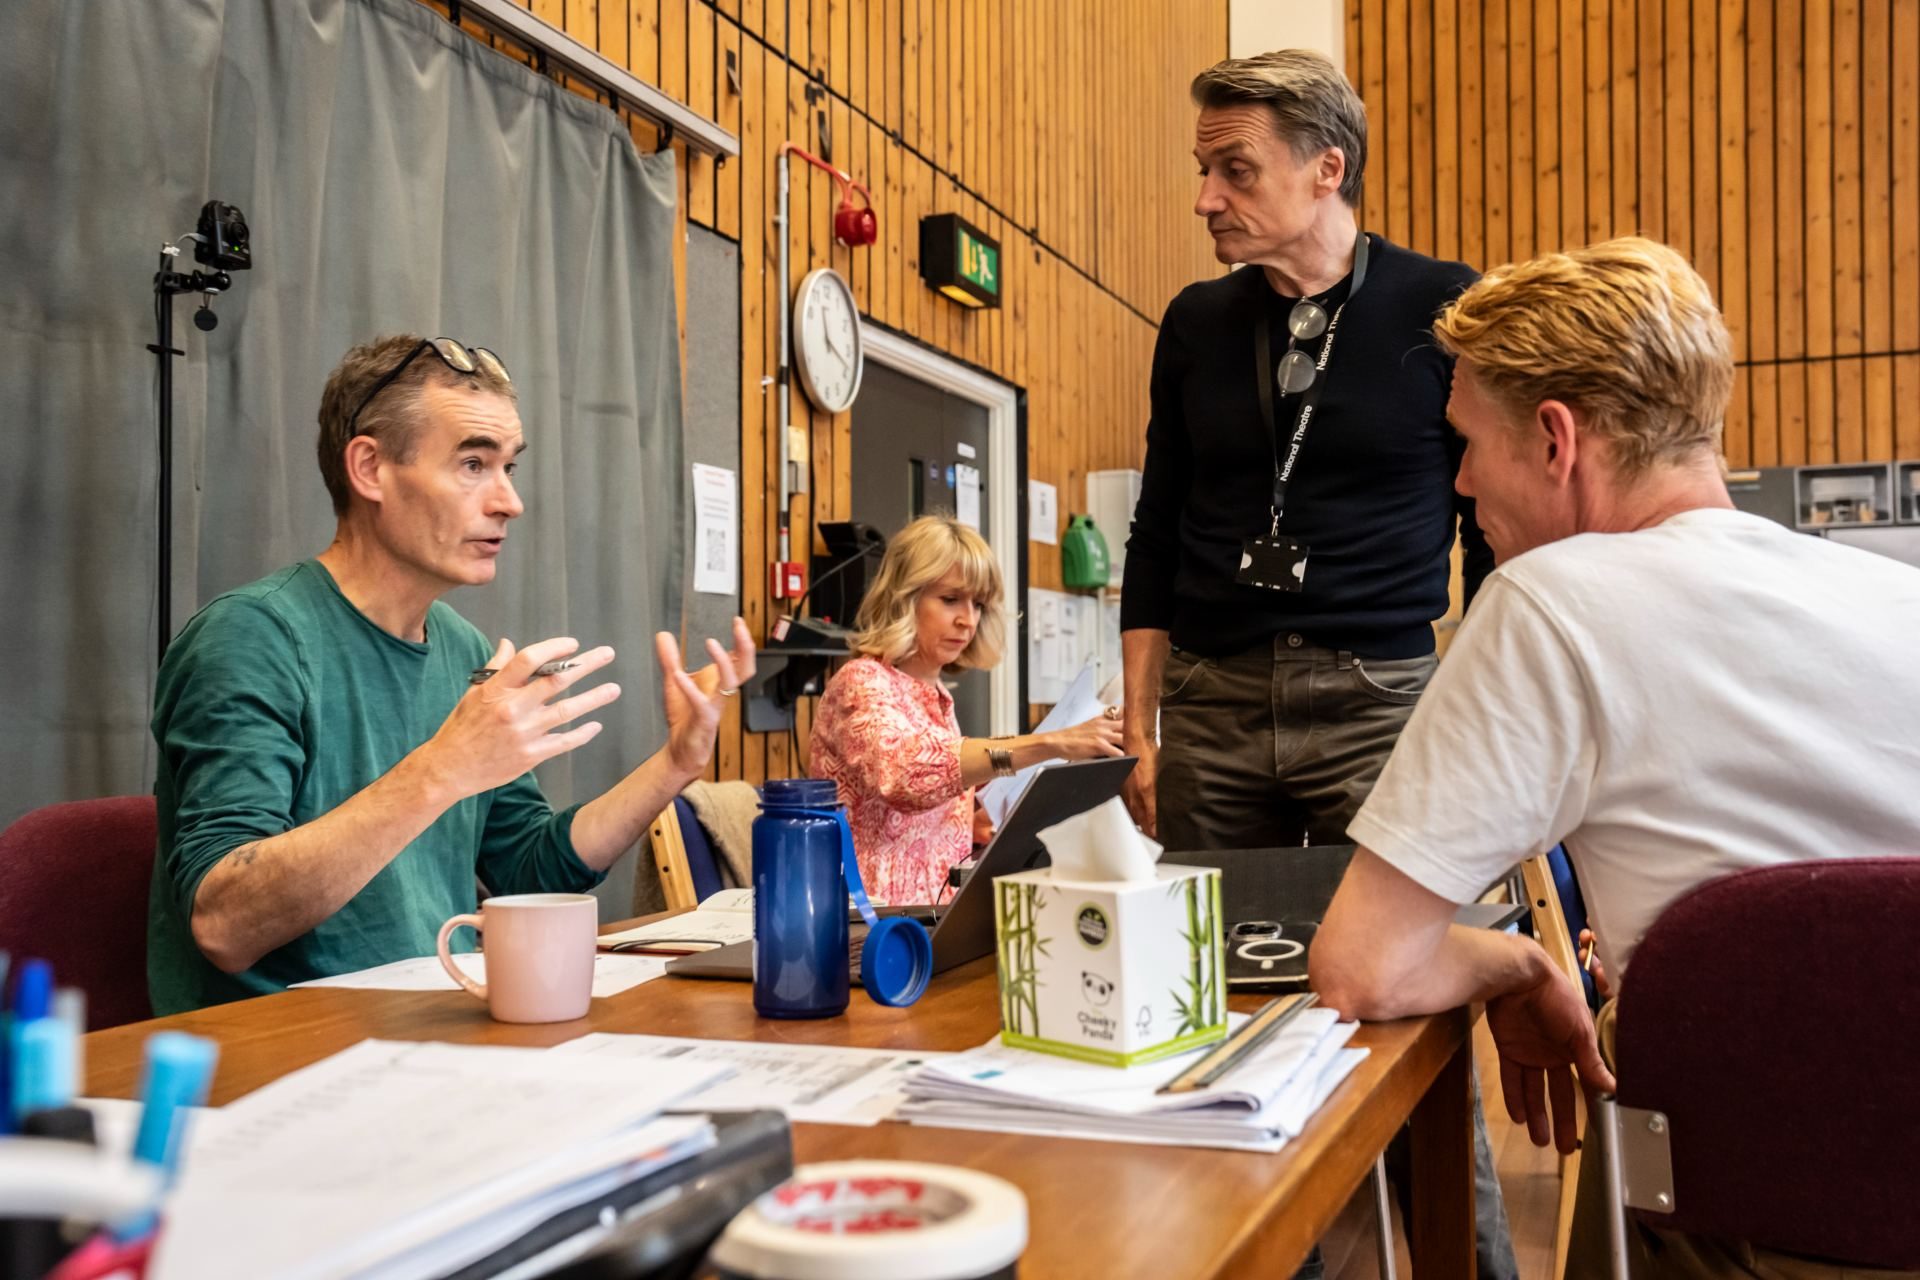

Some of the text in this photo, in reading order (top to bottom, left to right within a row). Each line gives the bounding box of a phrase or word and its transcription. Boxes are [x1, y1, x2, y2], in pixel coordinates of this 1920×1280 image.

[1315, 333, 1335, 371] National
[1279, 405, 1313, 482] National Theatre
[1083, 1024, 1114, 1042] Panda
